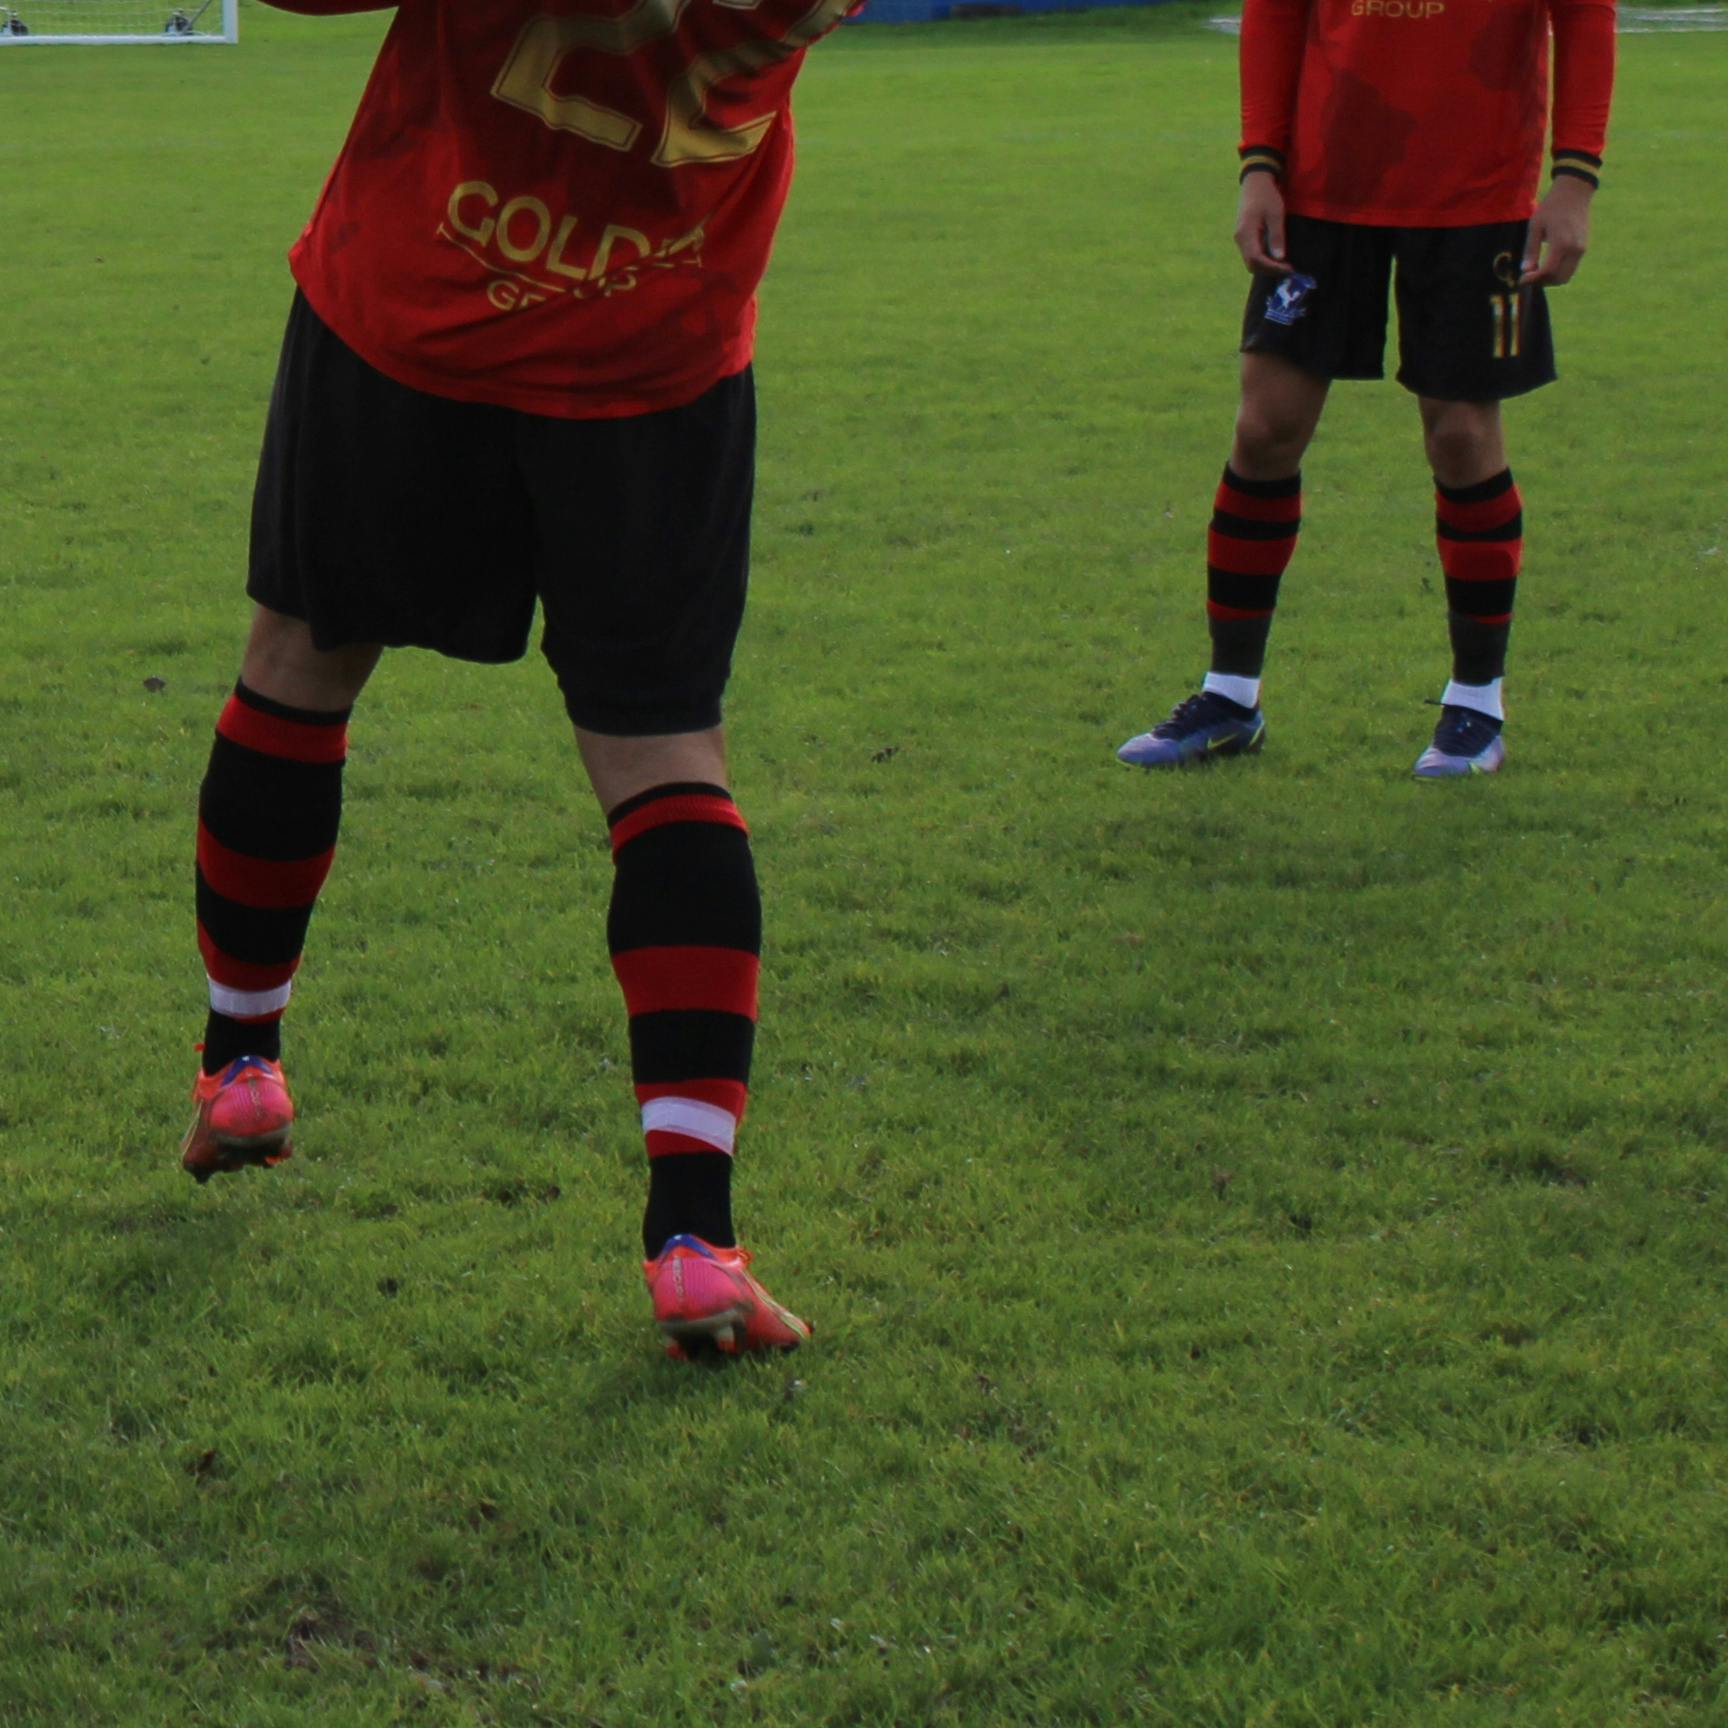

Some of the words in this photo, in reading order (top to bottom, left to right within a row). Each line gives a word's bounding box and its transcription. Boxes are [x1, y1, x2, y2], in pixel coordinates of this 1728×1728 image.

[1351, 0, 1445, 19] GROUP
[447, 180, 705, 281] GOLD
[1489, 293, 1520, 358] 11
